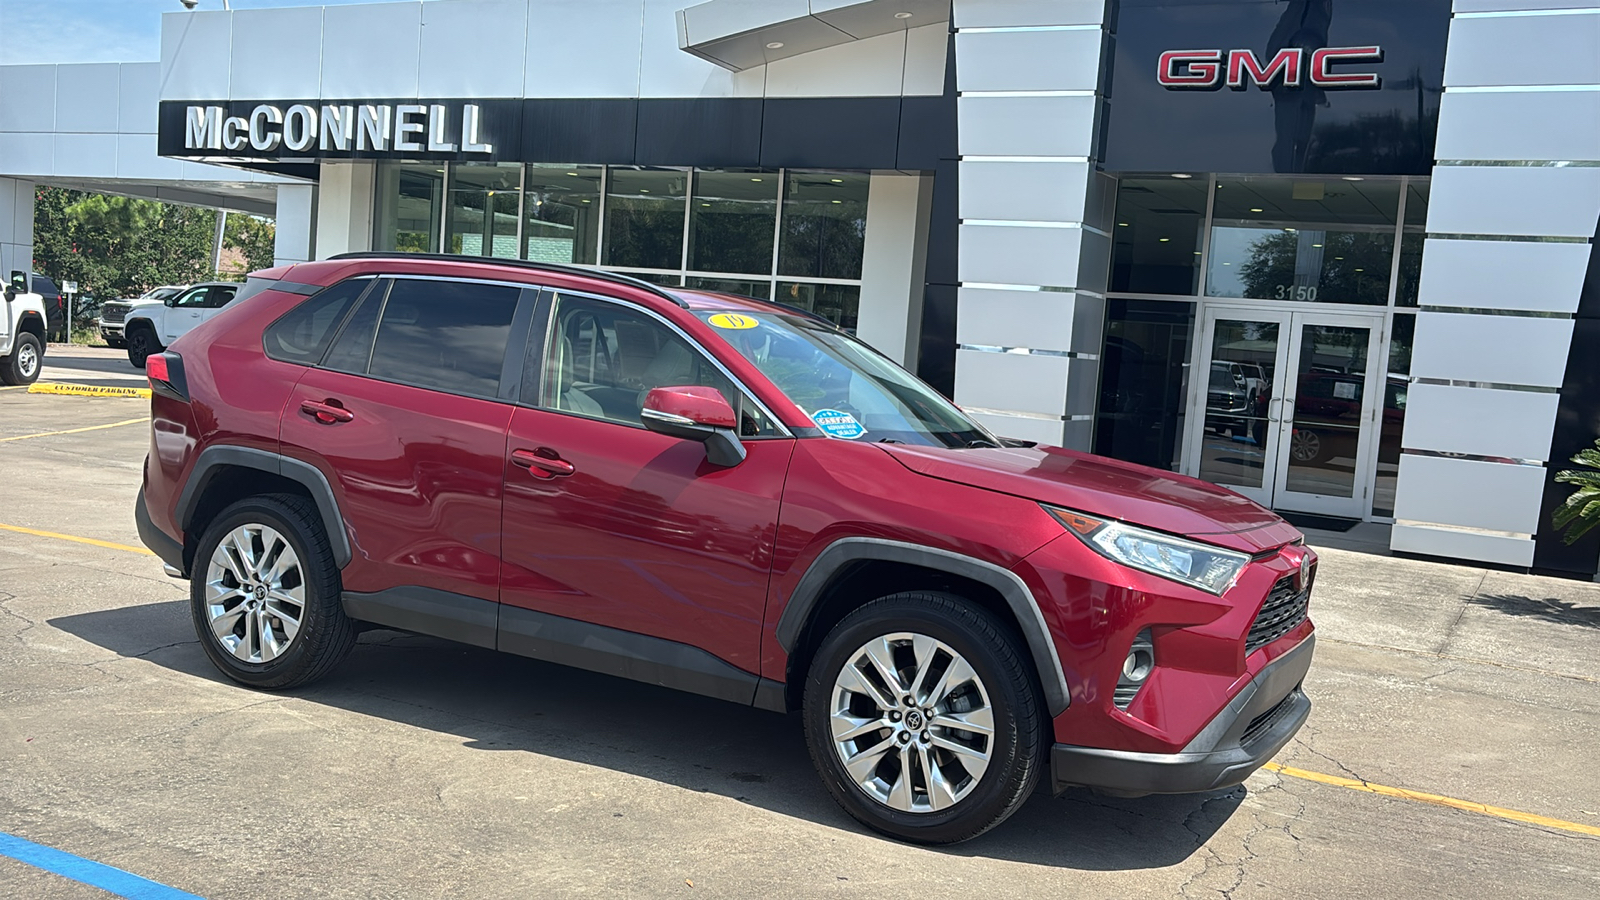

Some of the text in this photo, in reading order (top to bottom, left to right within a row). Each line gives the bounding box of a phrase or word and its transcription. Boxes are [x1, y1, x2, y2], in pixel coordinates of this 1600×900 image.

[1156, 46, 1384, 89] GMC
[185, 104, 493, 154] McCONNELL
[1275, 284, 1318, 302] 3150
[724, 315, 745, 327] 19
[100, 387, 138, 395] PARKING
